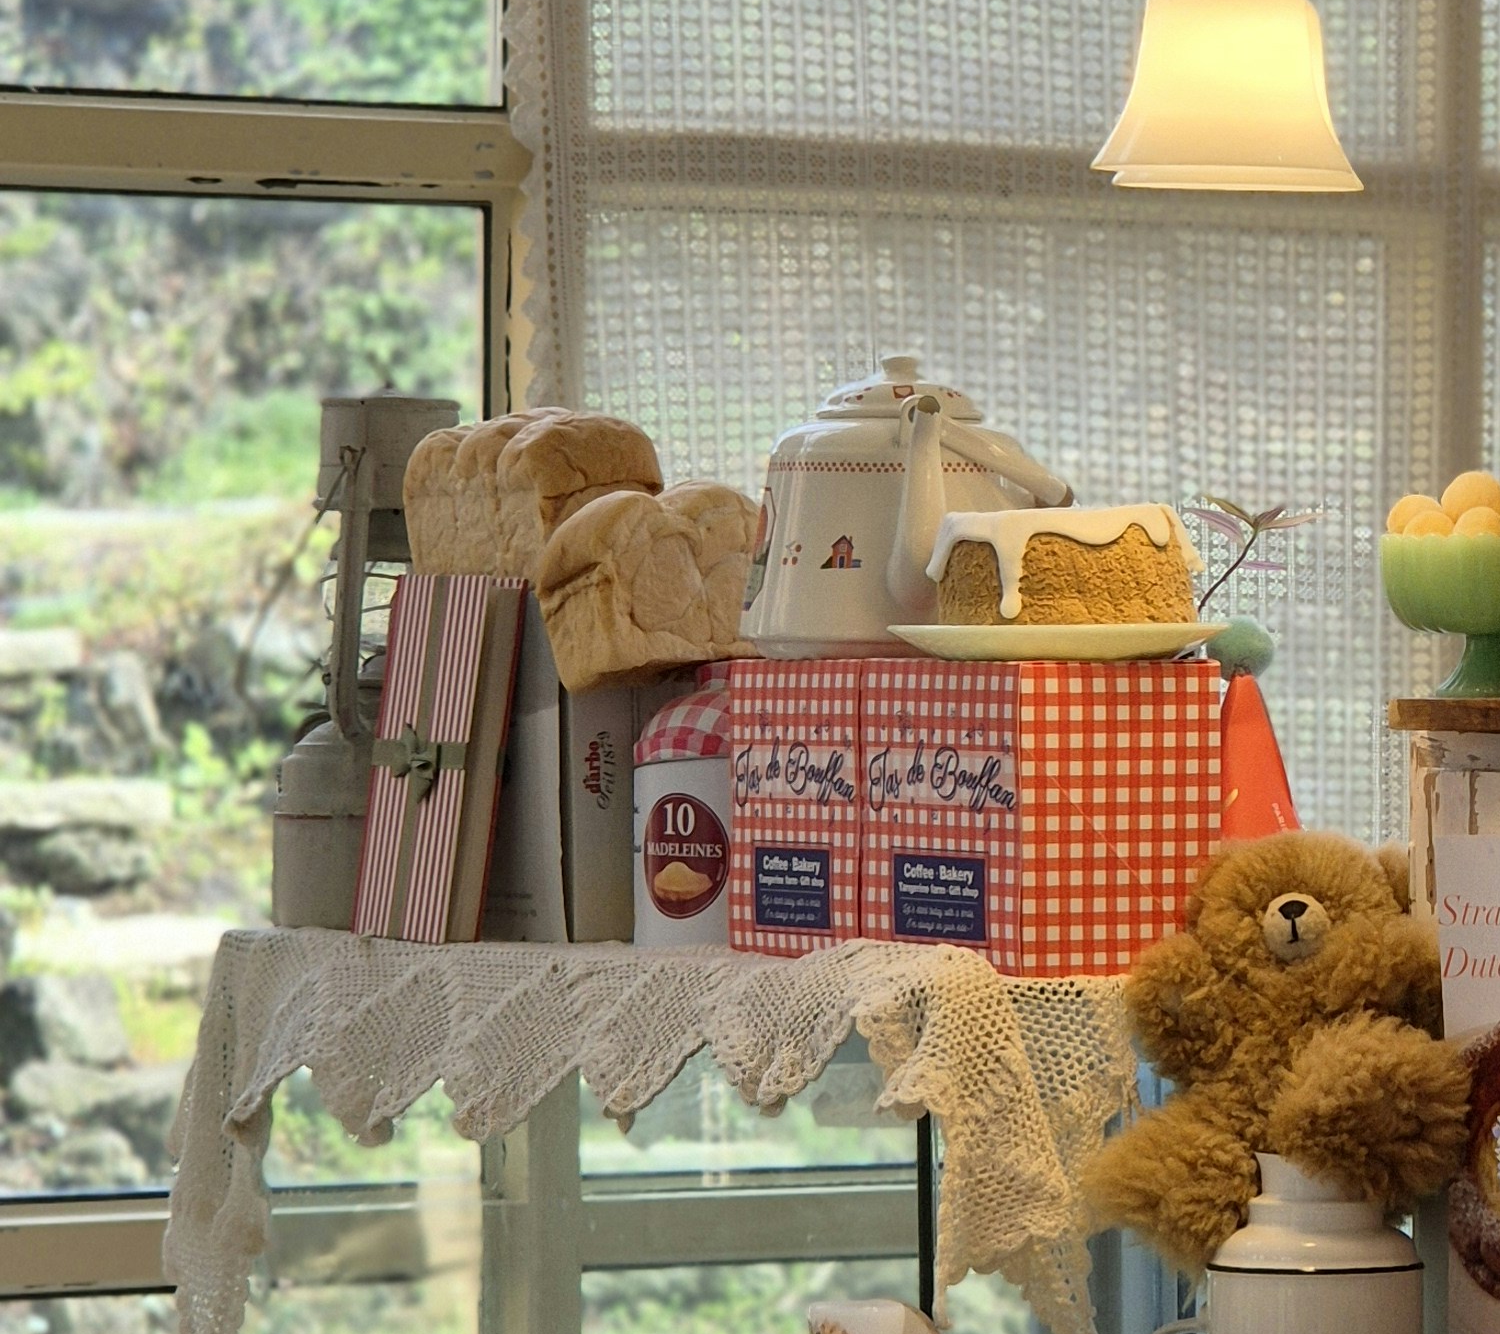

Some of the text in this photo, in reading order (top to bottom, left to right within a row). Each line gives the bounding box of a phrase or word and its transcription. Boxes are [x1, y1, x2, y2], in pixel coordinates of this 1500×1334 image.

[766, 735, 781, 781] de
[906, 738, 926, 787] de
[663, 801, 696, 837] 10
[646, 841, 723, 859] MADELEINES
[763, 855, 821, 876] Coffee Bakery
[903, 862, 974, 886] Coffee Bakery
